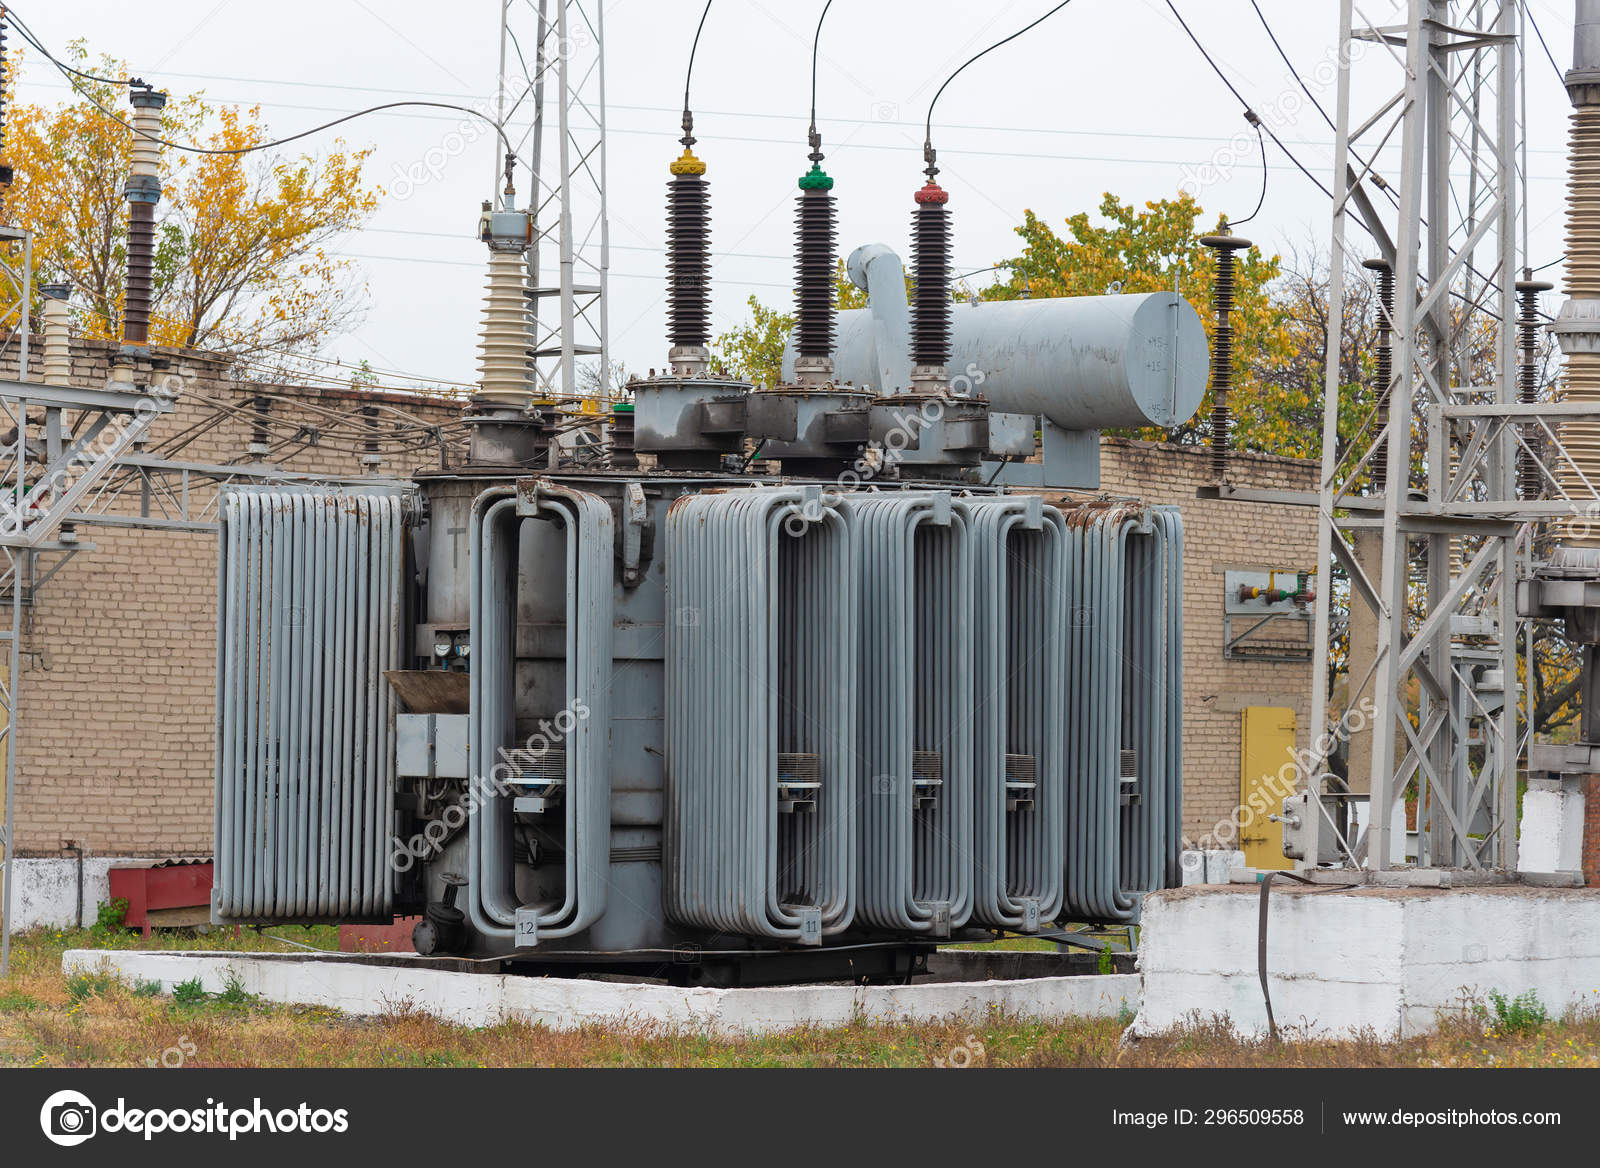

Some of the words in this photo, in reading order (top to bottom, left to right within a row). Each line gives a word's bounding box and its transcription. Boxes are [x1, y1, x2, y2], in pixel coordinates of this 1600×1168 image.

[447, 527, 467, 569] T
[1030, 907, 1036, 919] 9
[519, 921, 535, 935] 12
[806, 920, 817, 933] 11
